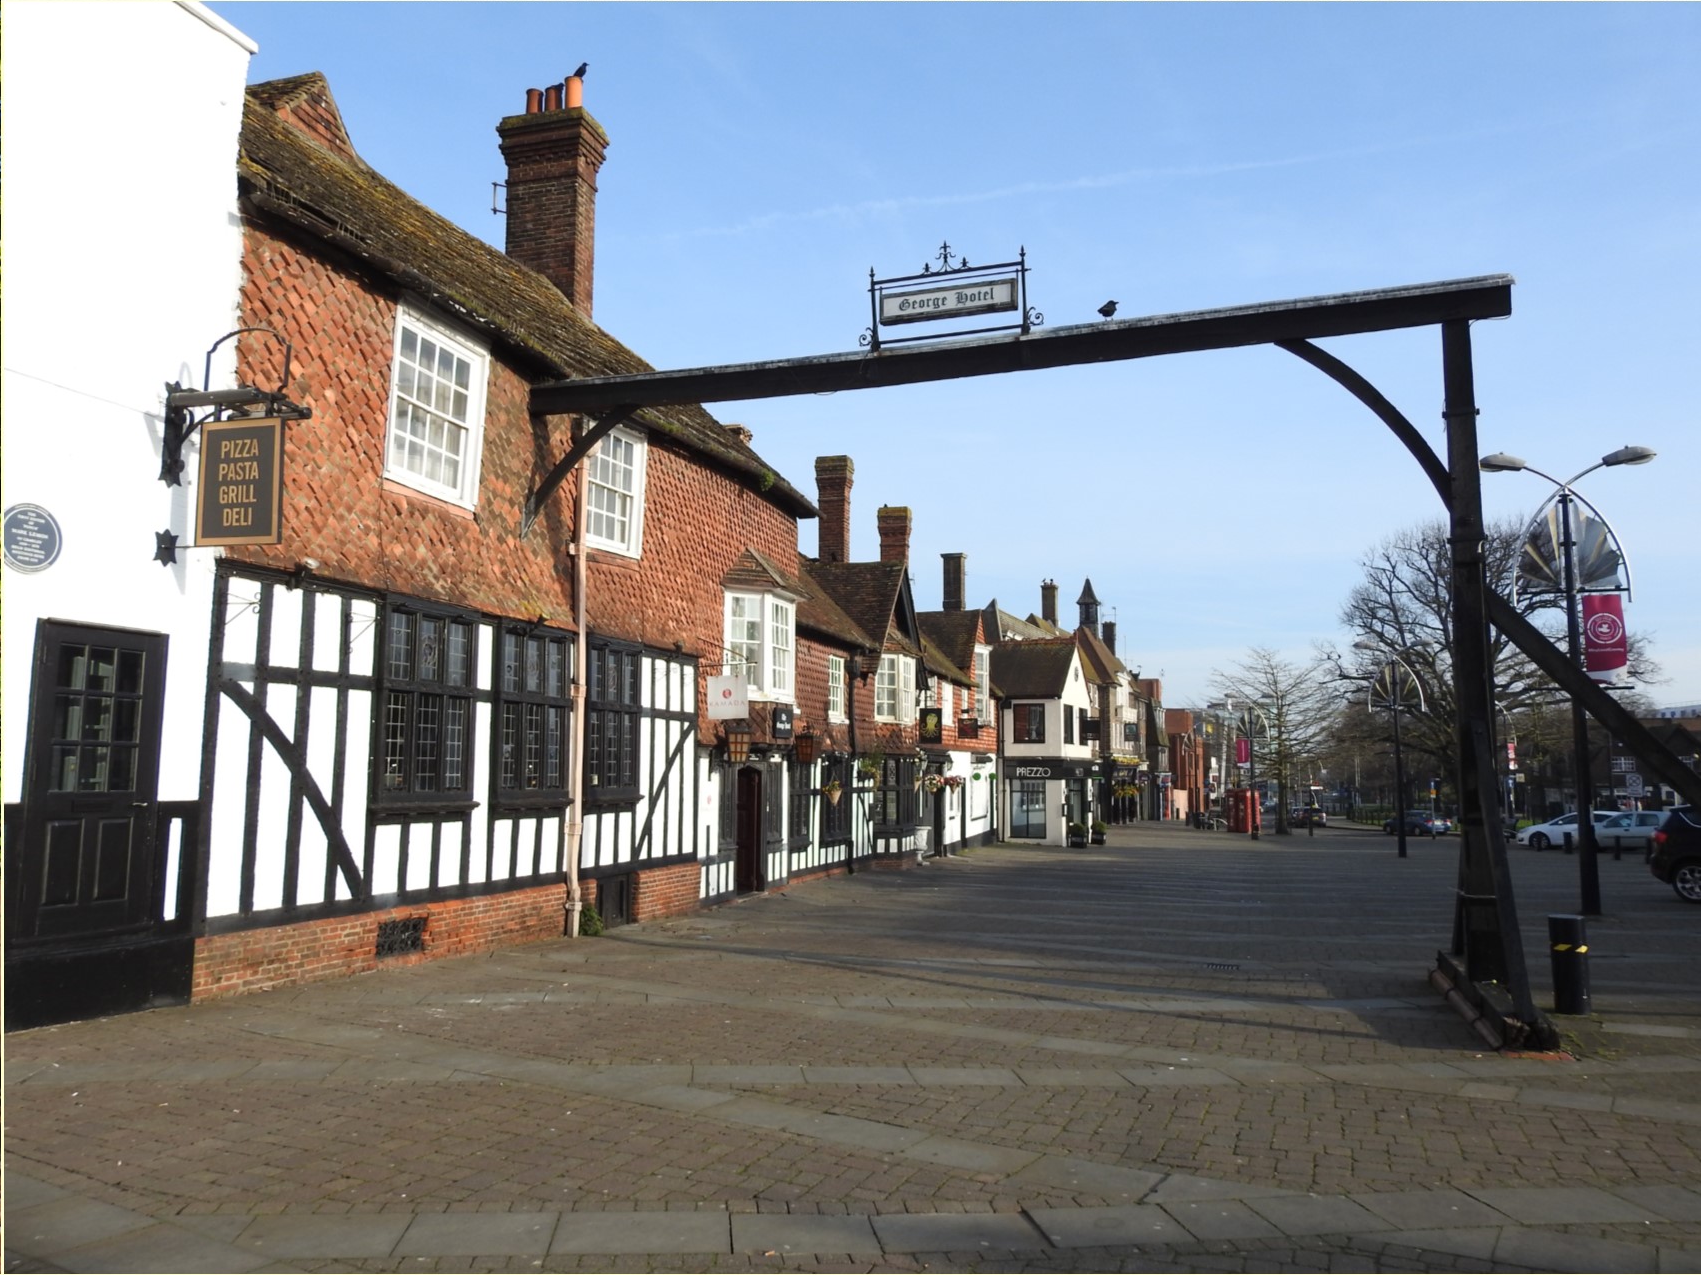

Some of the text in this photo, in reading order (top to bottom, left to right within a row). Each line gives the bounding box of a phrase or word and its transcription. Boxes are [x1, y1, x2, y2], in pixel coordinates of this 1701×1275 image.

[899, 287, 995, 312] George Hotel
[221, 438, 259, 459] PIZZA
[219, 461, 259, 482] PASTA
[219, 484, 257, 504] GRILL
[223, 507, 252, 527] DELI
[1016, 766, 1051, 777] PREZZO
